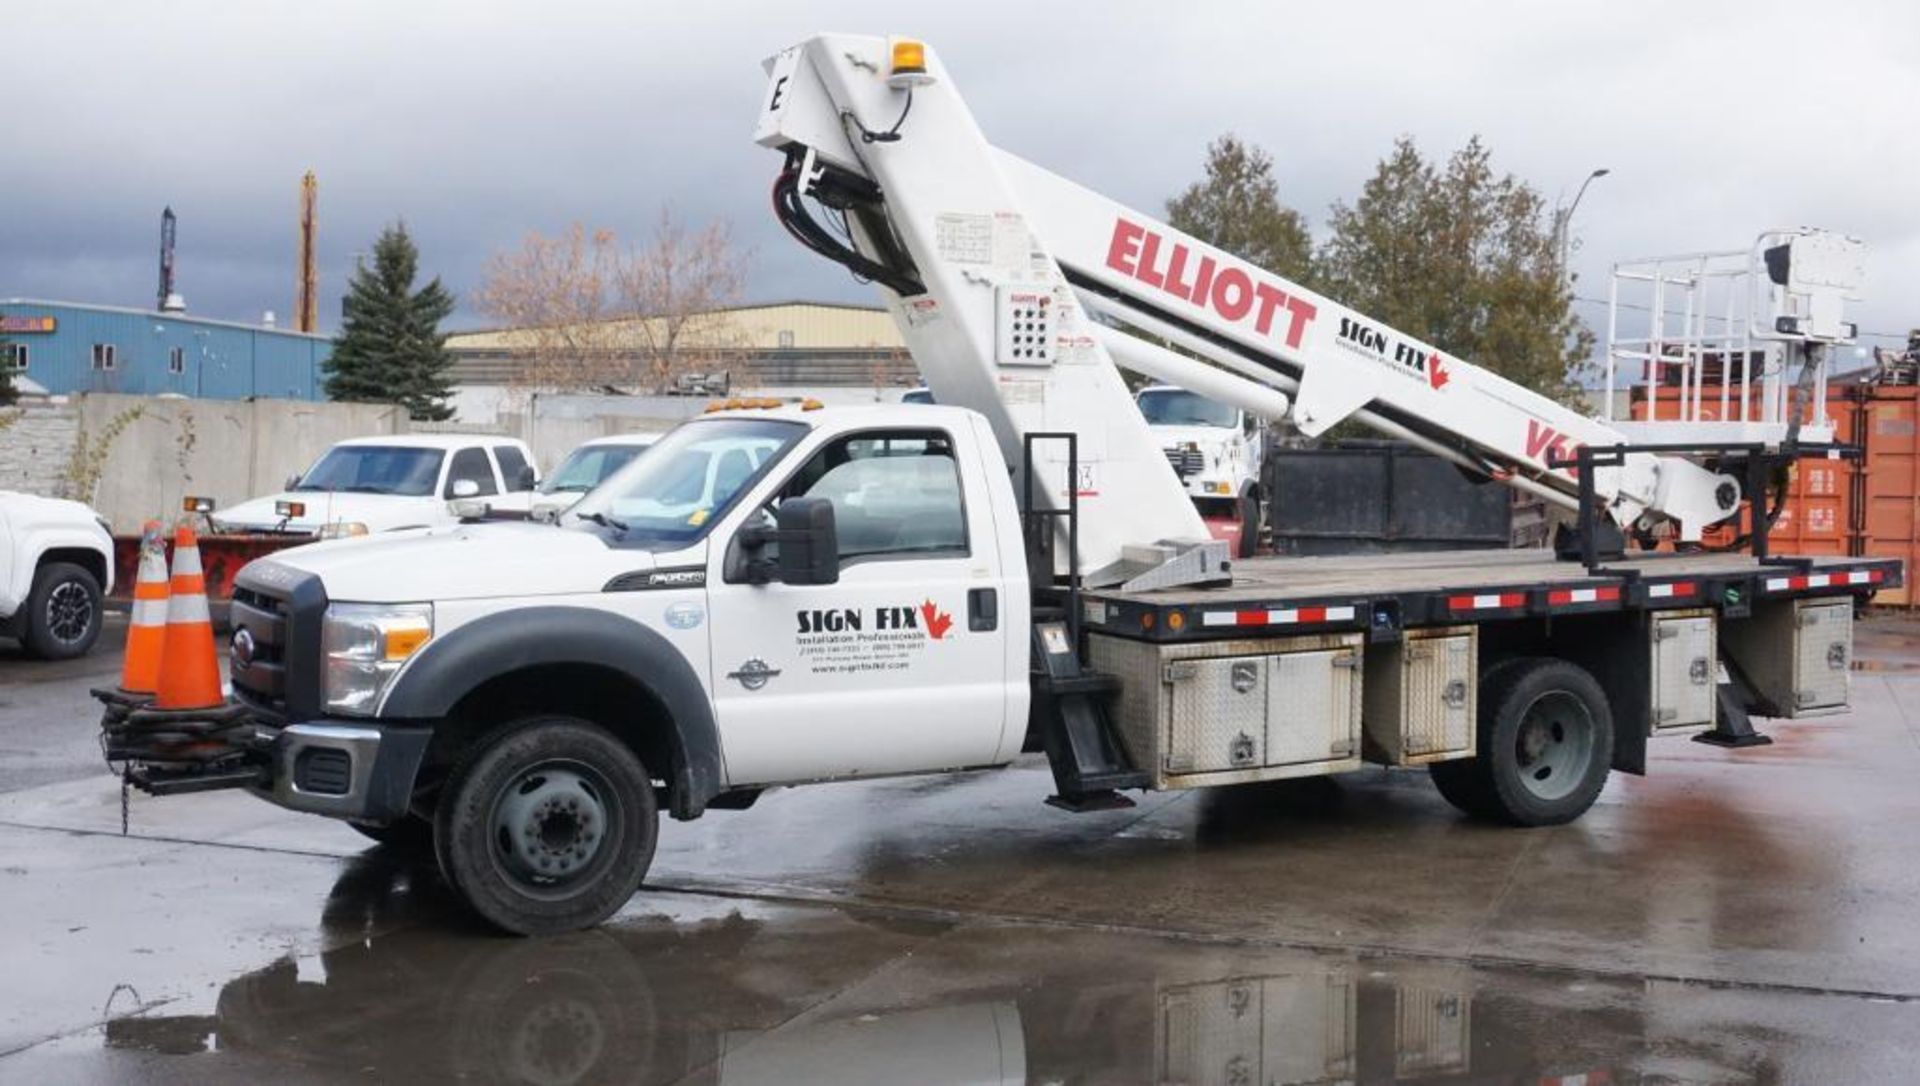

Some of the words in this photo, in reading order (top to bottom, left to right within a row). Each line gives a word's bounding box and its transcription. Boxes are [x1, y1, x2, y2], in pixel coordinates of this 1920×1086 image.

[769, 75, 789, 111] E
[1106, 218, 1317, 349] ELLIOTT
[1338, 317, 1389, 355] SIGN
[1395, 341, 1429, 372] FIX
[797, 608, 862, 633] SIGN
[876, 606, 918, 630] FIX
[796, 634, 854, 645] Installation
[857, 632, 926, 642] Professionals
